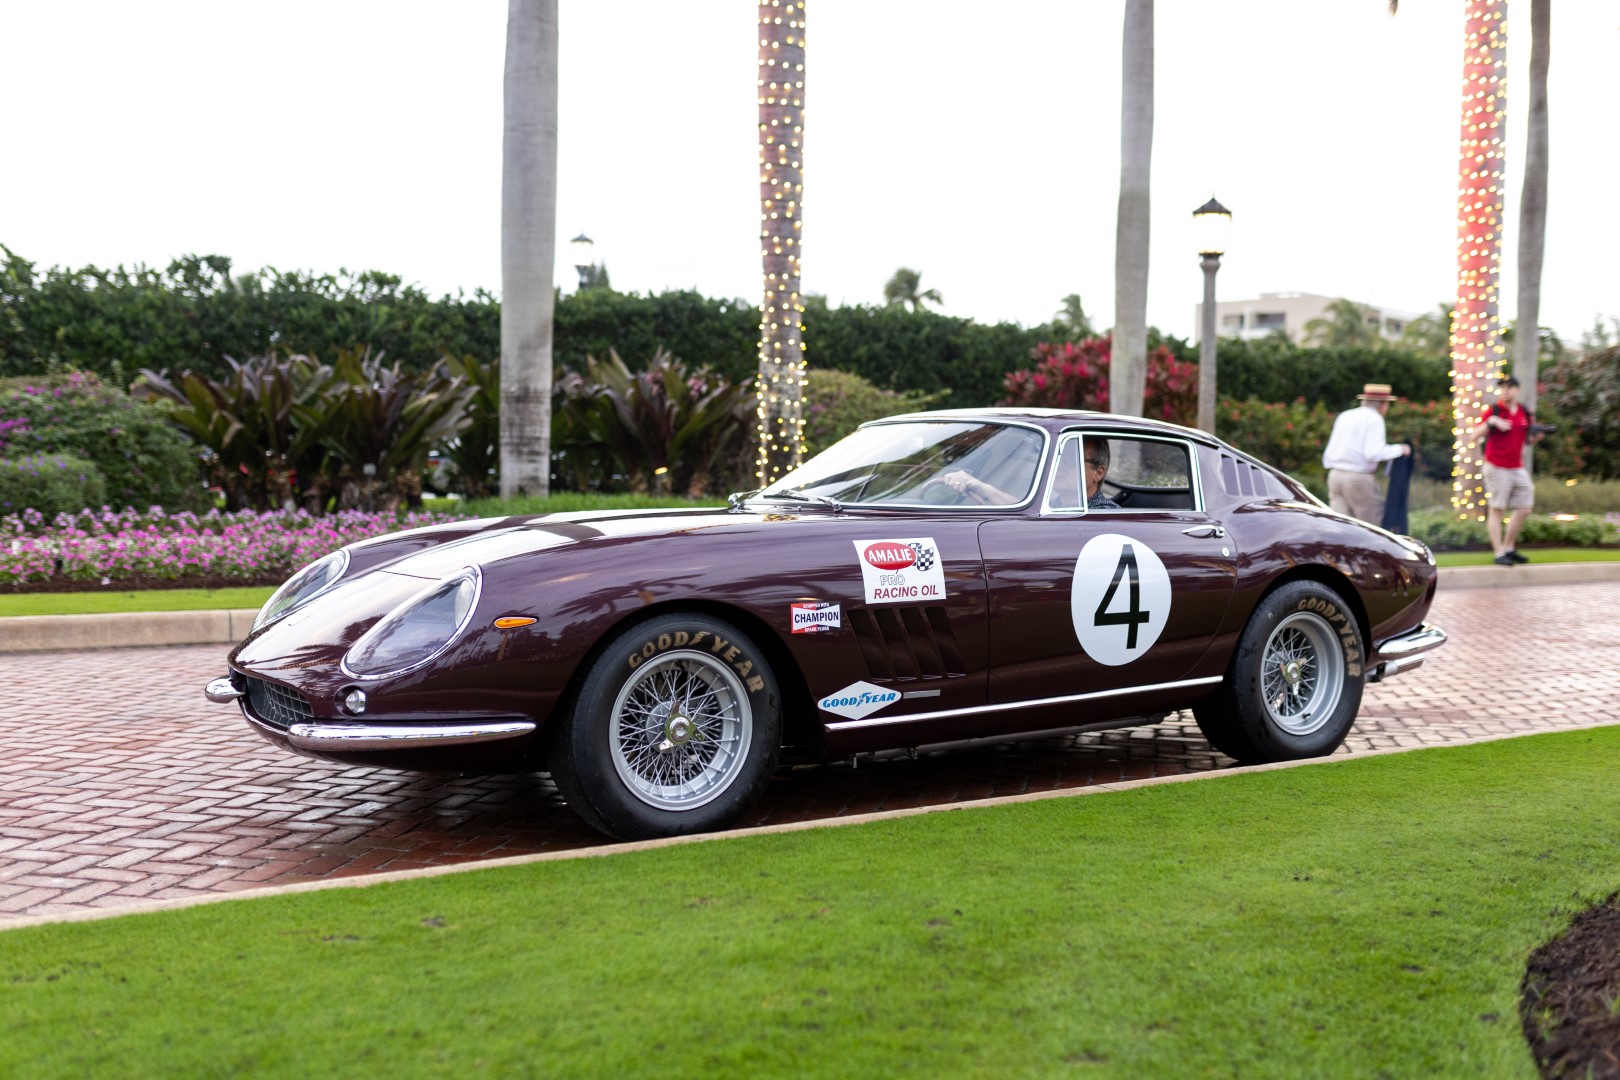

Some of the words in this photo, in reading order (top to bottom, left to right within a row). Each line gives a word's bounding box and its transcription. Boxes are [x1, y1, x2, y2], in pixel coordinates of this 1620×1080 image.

[868, 549, 913, 562] AMALIE
[880, 574, 906, 586] PRO
[874, 586, 918, 600] RACING
[921, 585, 939, 596] OIL
[1094, 544, 1150, 649] 4
[794, 611, 839, 624] CHAMPION
[1298, 598, 1361, 677] GOODYEAR
[627, 631, 764, 693] GOODYEAR
[822, 692, 897, 708] GOODYEAR
